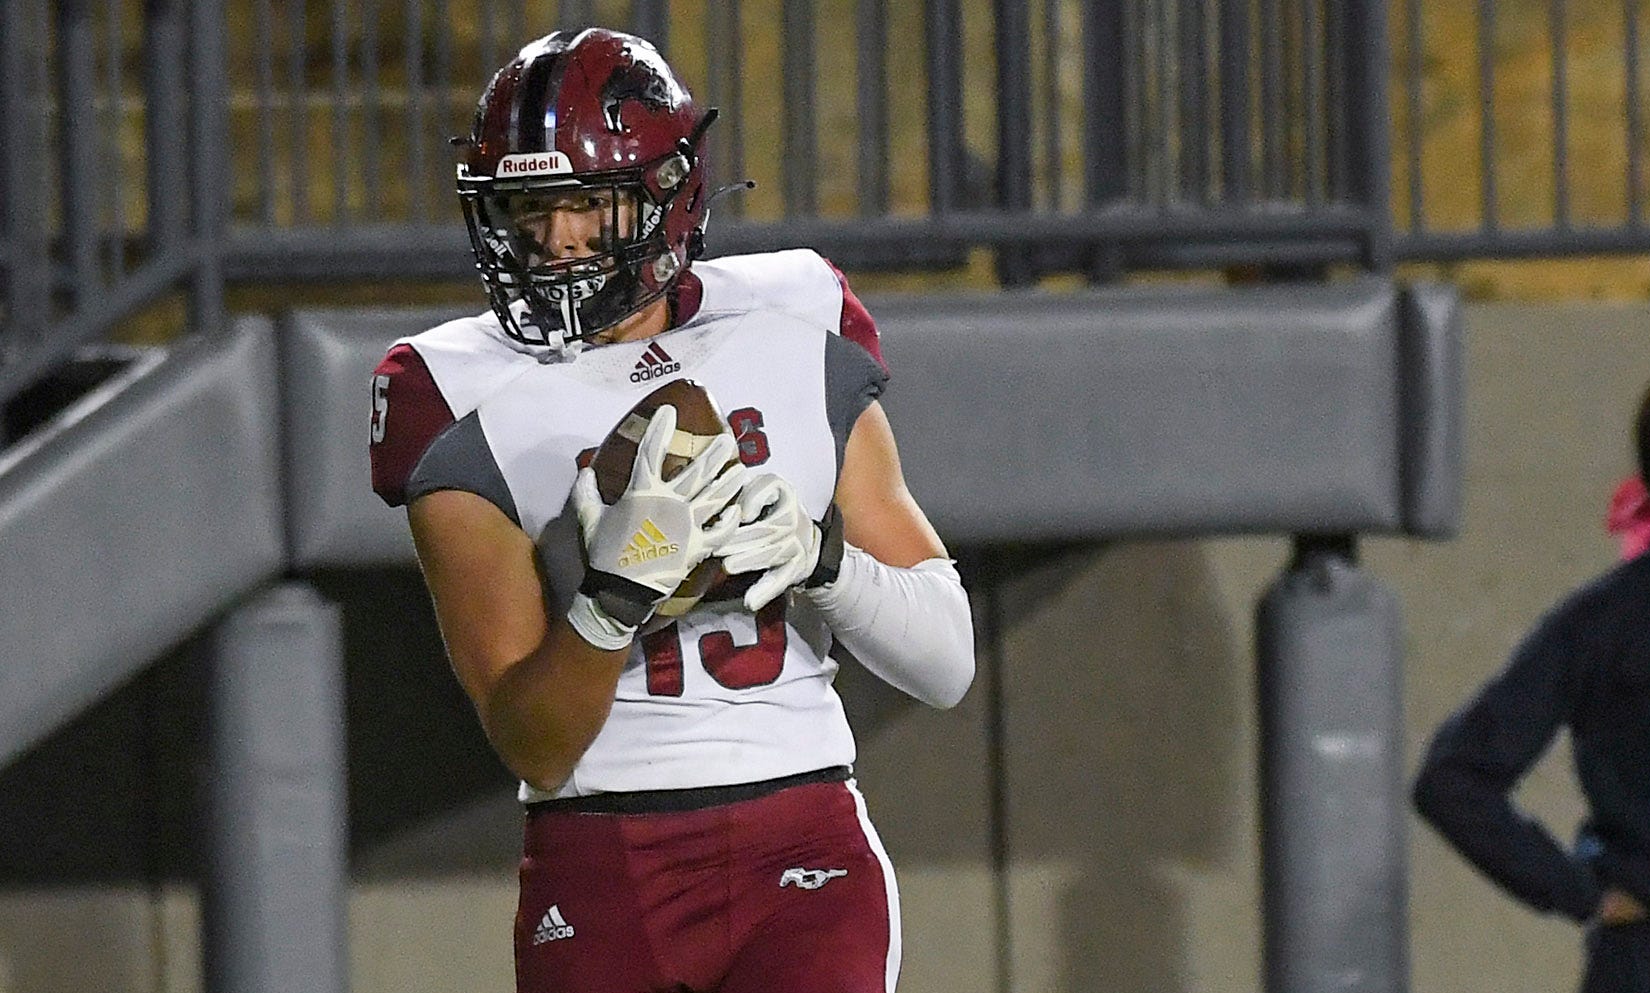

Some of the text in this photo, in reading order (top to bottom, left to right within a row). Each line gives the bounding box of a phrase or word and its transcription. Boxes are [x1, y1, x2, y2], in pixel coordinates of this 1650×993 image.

[502, 156, 560, 173] Riddell
[629, 361, 681, 383] adidas
[618, 543, 680, 568] adidas
[533, 925, 575, 946] adidas
